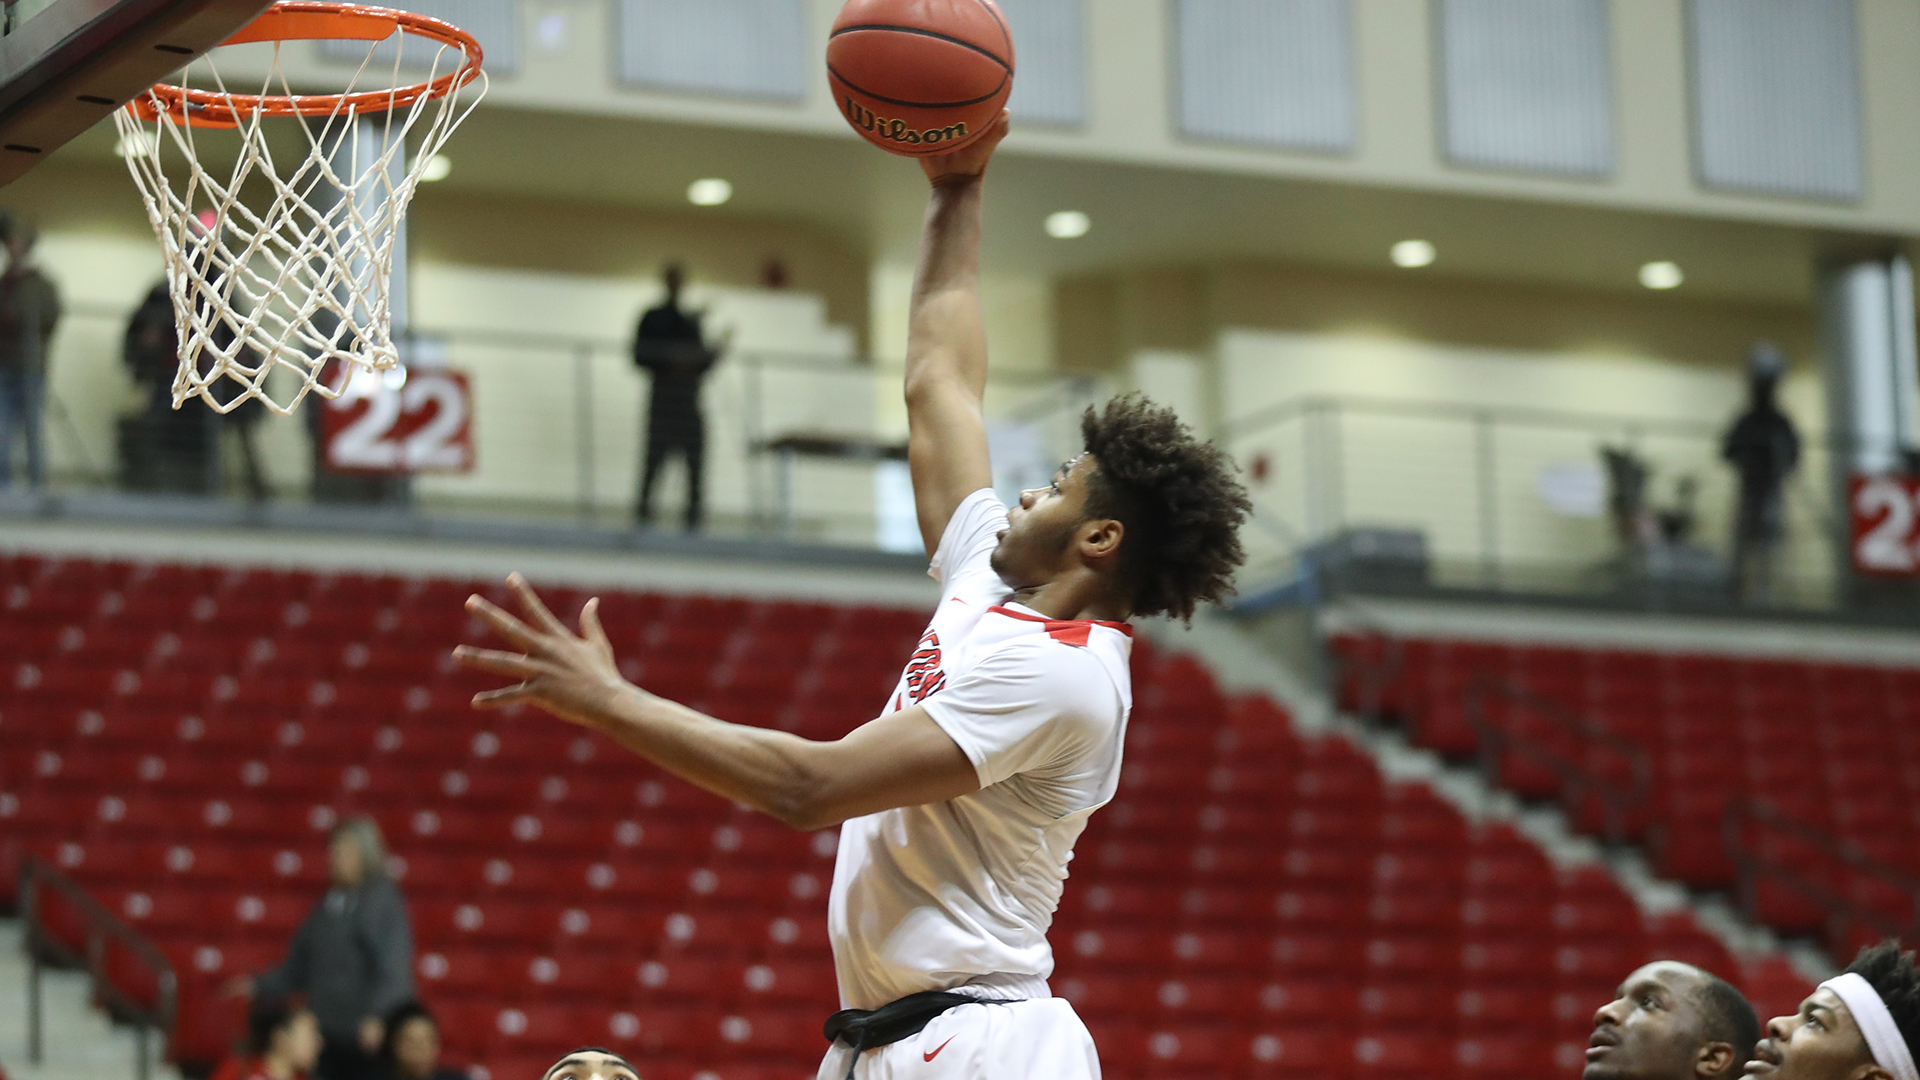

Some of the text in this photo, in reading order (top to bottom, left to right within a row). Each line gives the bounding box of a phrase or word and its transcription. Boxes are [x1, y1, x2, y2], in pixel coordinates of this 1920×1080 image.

[844, 95, 968, 144] Wilson
[328, 370, 463, 467] 22
[1855, 482, 1920, 570] 2
